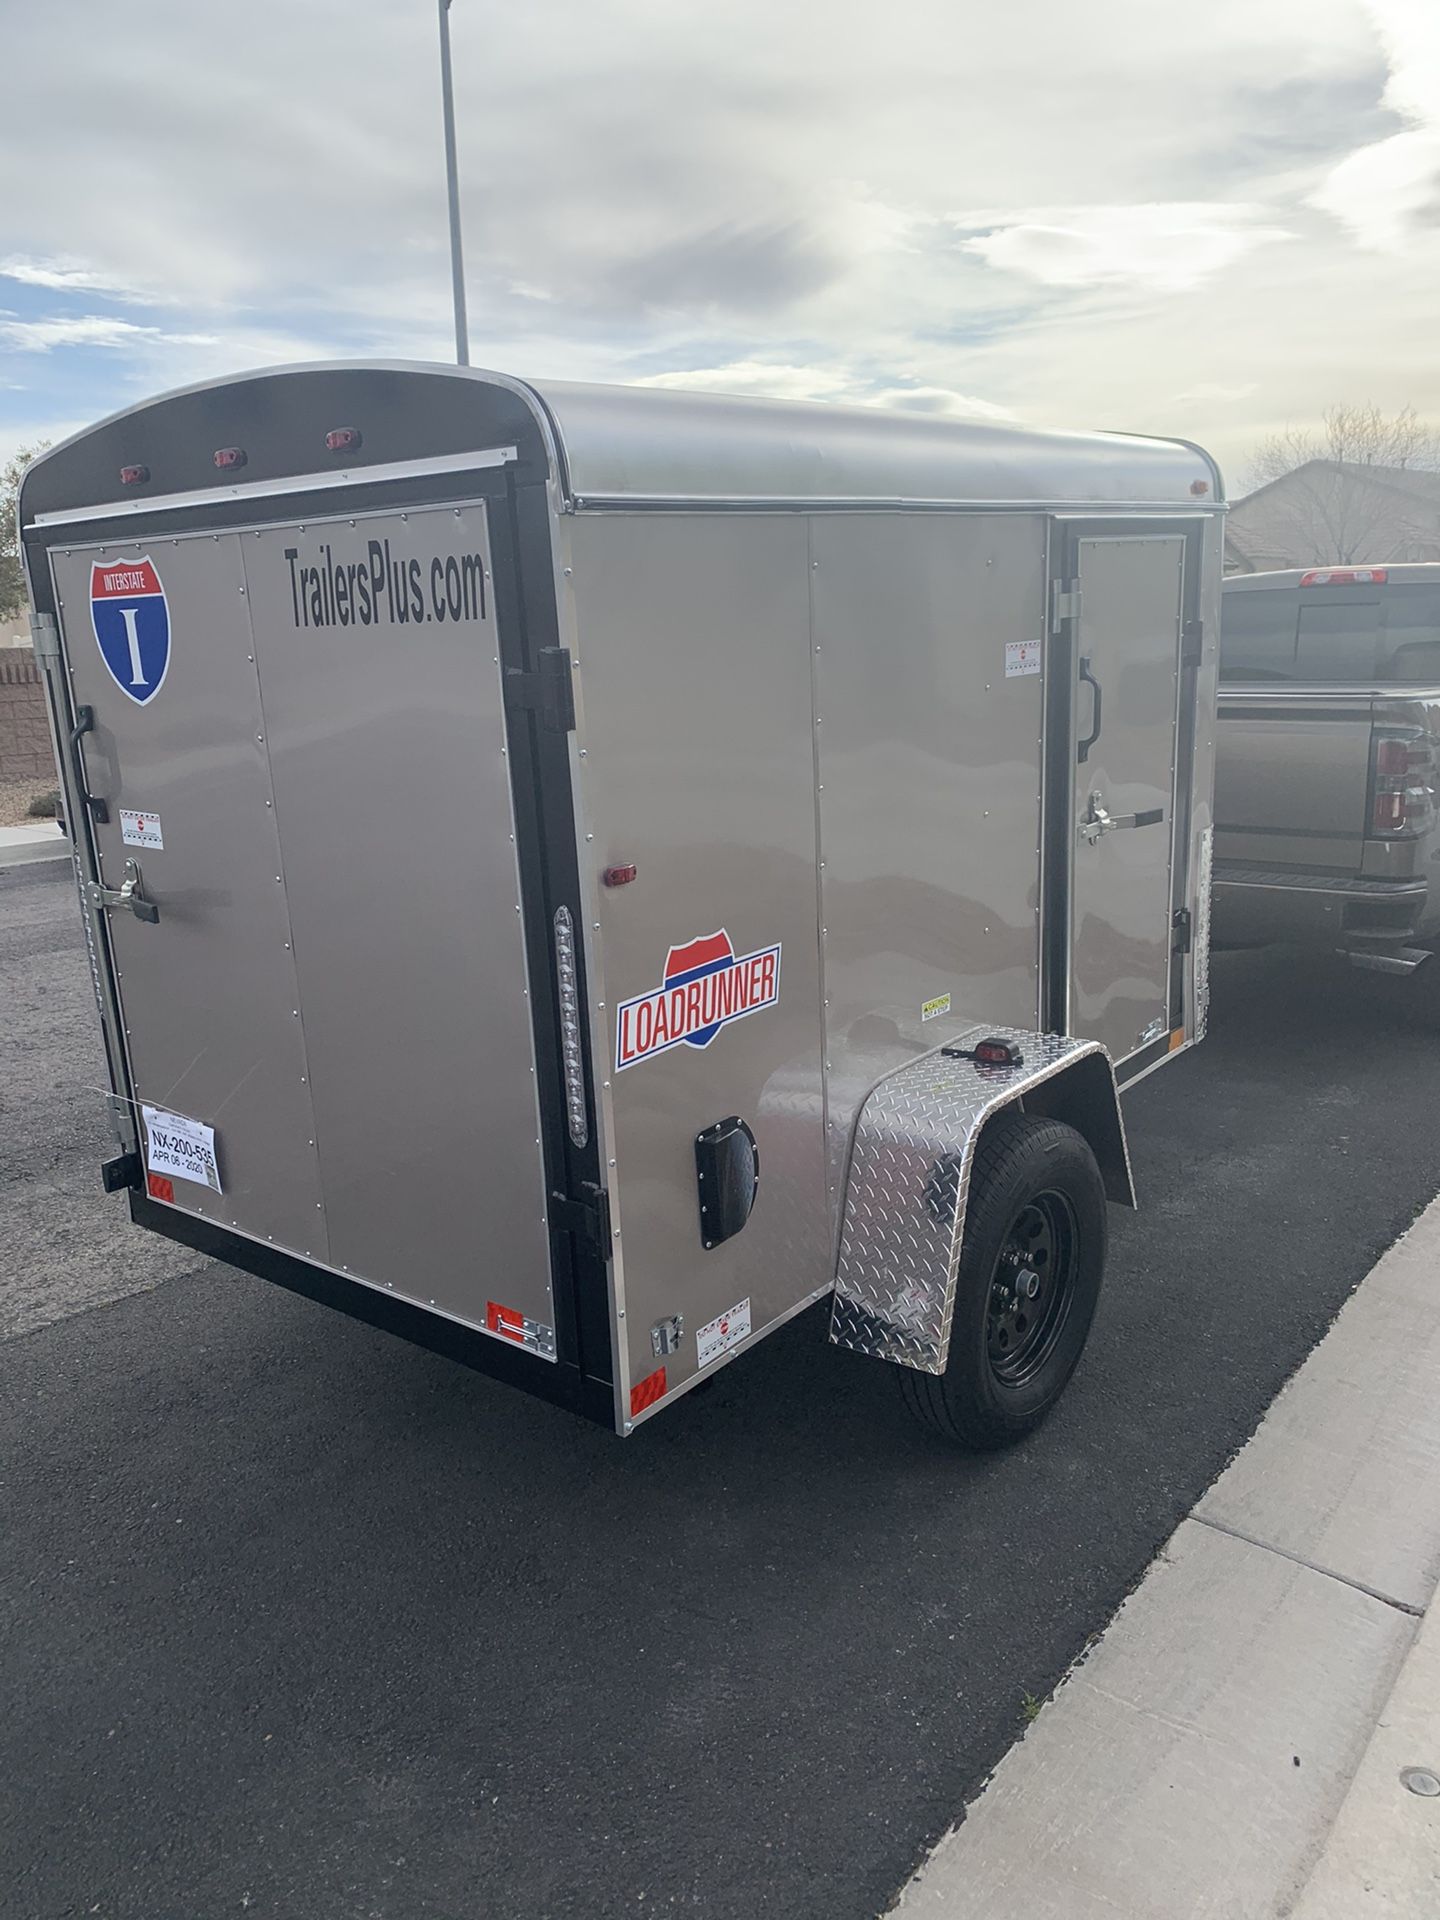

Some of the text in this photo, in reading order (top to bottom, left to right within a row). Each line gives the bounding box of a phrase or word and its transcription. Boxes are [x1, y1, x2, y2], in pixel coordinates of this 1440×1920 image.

[103, 571, 146, 592] INTERSTATE
[284, 538, 486, 627] TrailersPlus.com
[622, 954, 775, 1061] LOADRUNNER
[152, 1129, 214, 1167] NX-200-535
[153, 1149, 170, 1164] APR
